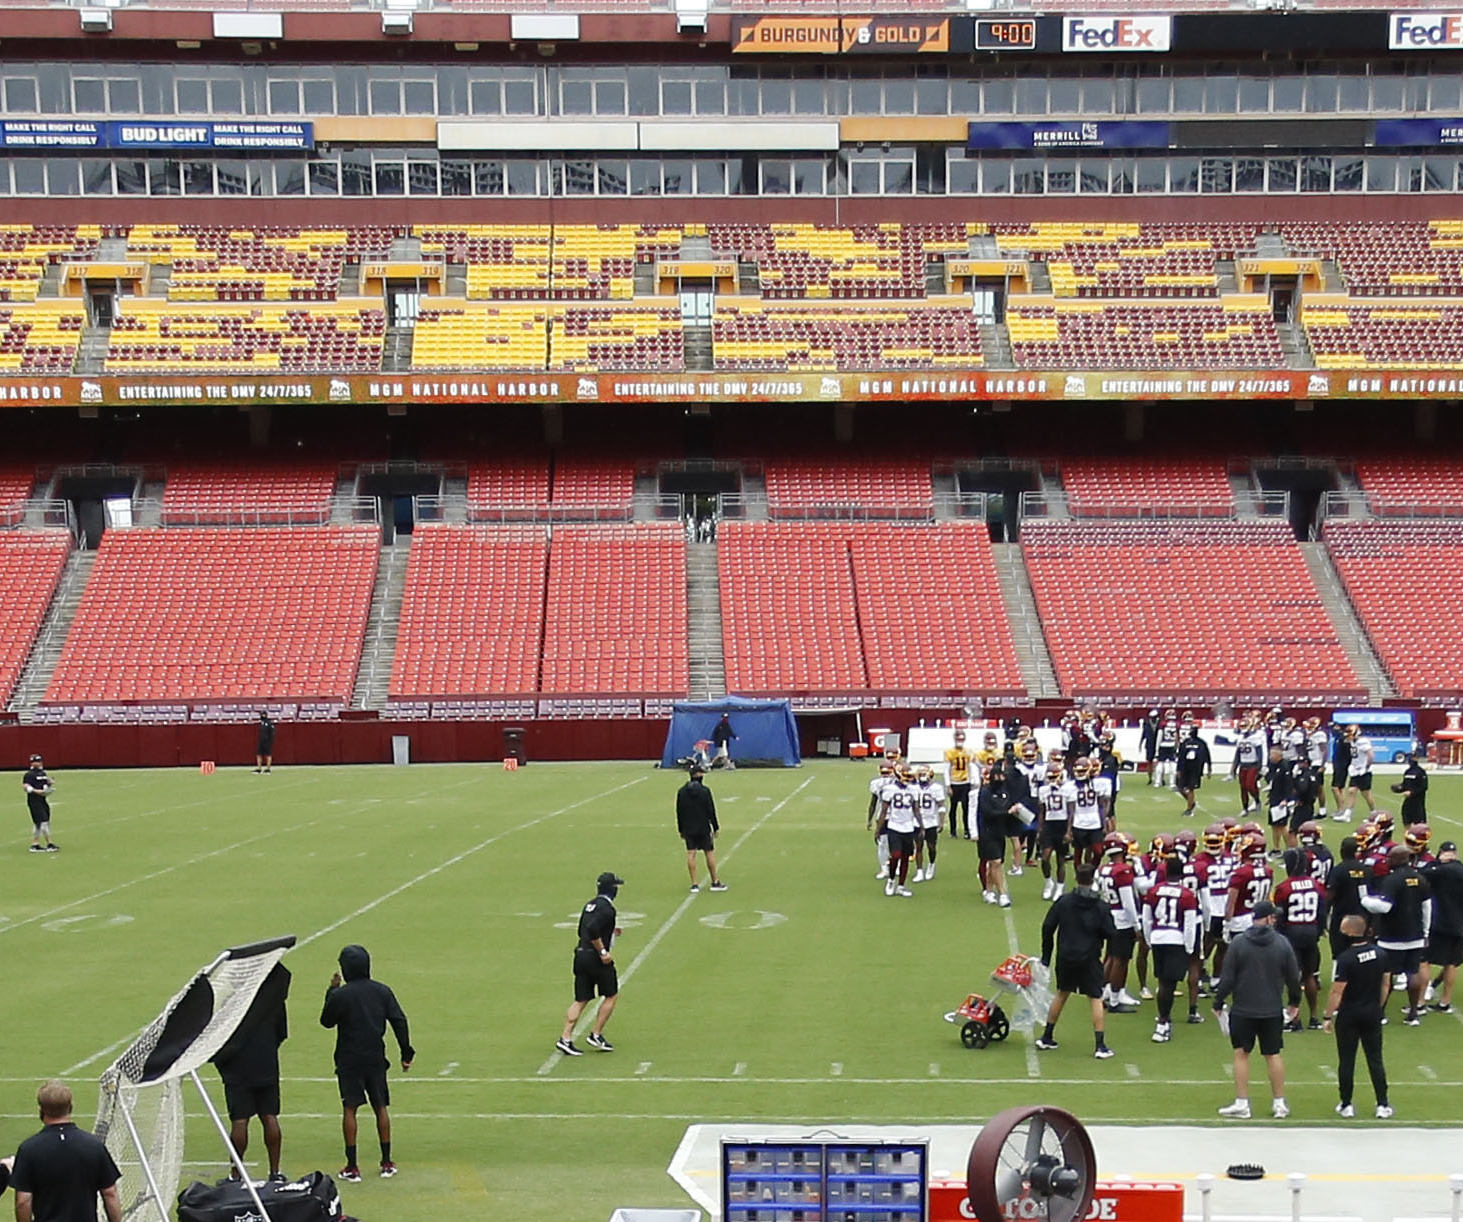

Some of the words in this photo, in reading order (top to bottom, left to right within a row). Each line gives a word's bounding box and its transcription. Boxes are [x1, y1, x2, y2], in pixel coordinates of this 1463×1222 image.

[761, 27, 855, 43] BURGUNDY
[857, 26, 873, 44] &
[875, 27, 920, 43] GOLD
[991, 25, 1032, 43] 9:00
[1069, 20, 1154, 47] FedEx
[5, 123, 30, 132] MAKE
[31, 123, 47, 132] THE
[48, 123, 73, 132] RIGHT
[75, 124, 97, 132] CALL
[214, 124, 238, 133] MAKE
[239, 125, 254, 133] THE
[256, 125, 280, 133] RIGHT
[281, 125, 303, 134] CALL
[5, 136, 34, 145] DRINK
[36, 136, 97, 145] RESPONSIBLY
[122, 128, 158, 143] BUD
[159, 128, 207, 143] LIGHT
[214, 137, 242, 146] DRINK
[244, 137, 305, 146] RESPONSIBLY
[1034, 132, 1080, 141] MERRILL
[73, 267, 88, 276] 317
[423, 267, 439, 276] 319
[664, 266, 679, 275] 319
[714, 266, 730, 275] 320
[120, 386, 202, 398] ENTERTAINING
[206, 386, 227, 398] THE
[232, 386, 255, 397] DMV
[260, 385, 311, 397] 24/7/365
[370, 384, 402, 396] MGM
[413, 383, 487, 396] NATIONAL
[498, 383, 558, 395] HARBOR
[615, 383, 695, 395] ENTERTAINING
[699, 382, 721, 395] THE
[724, 382, 747, 395] DMV
[752, 382, 802, 395] 24/7/365
[860, 381, 892, 393] MGM
[902, 380, 976, 393] NATIONAL
[986, 380, 1046, 392] HARBOR
[1102, 380, 1183, 393] ENTERTAINING
[1186, 380, 1207, 392] THE
[1211, 380, 1235, 392] DMV
[1239, 380, 1289, 392] 24/7/365
[1348, 379, 1381, 391] MGM
[0, 386, 61, 399] HARBOR
[893, 793, 912, 808] 83
[1078, 791, 1095, 807] 89
[1244, 879, 1271, 908] 30
[1155, 896, 1179, 928] 41
[1288, 892, 1318, 922] 29
